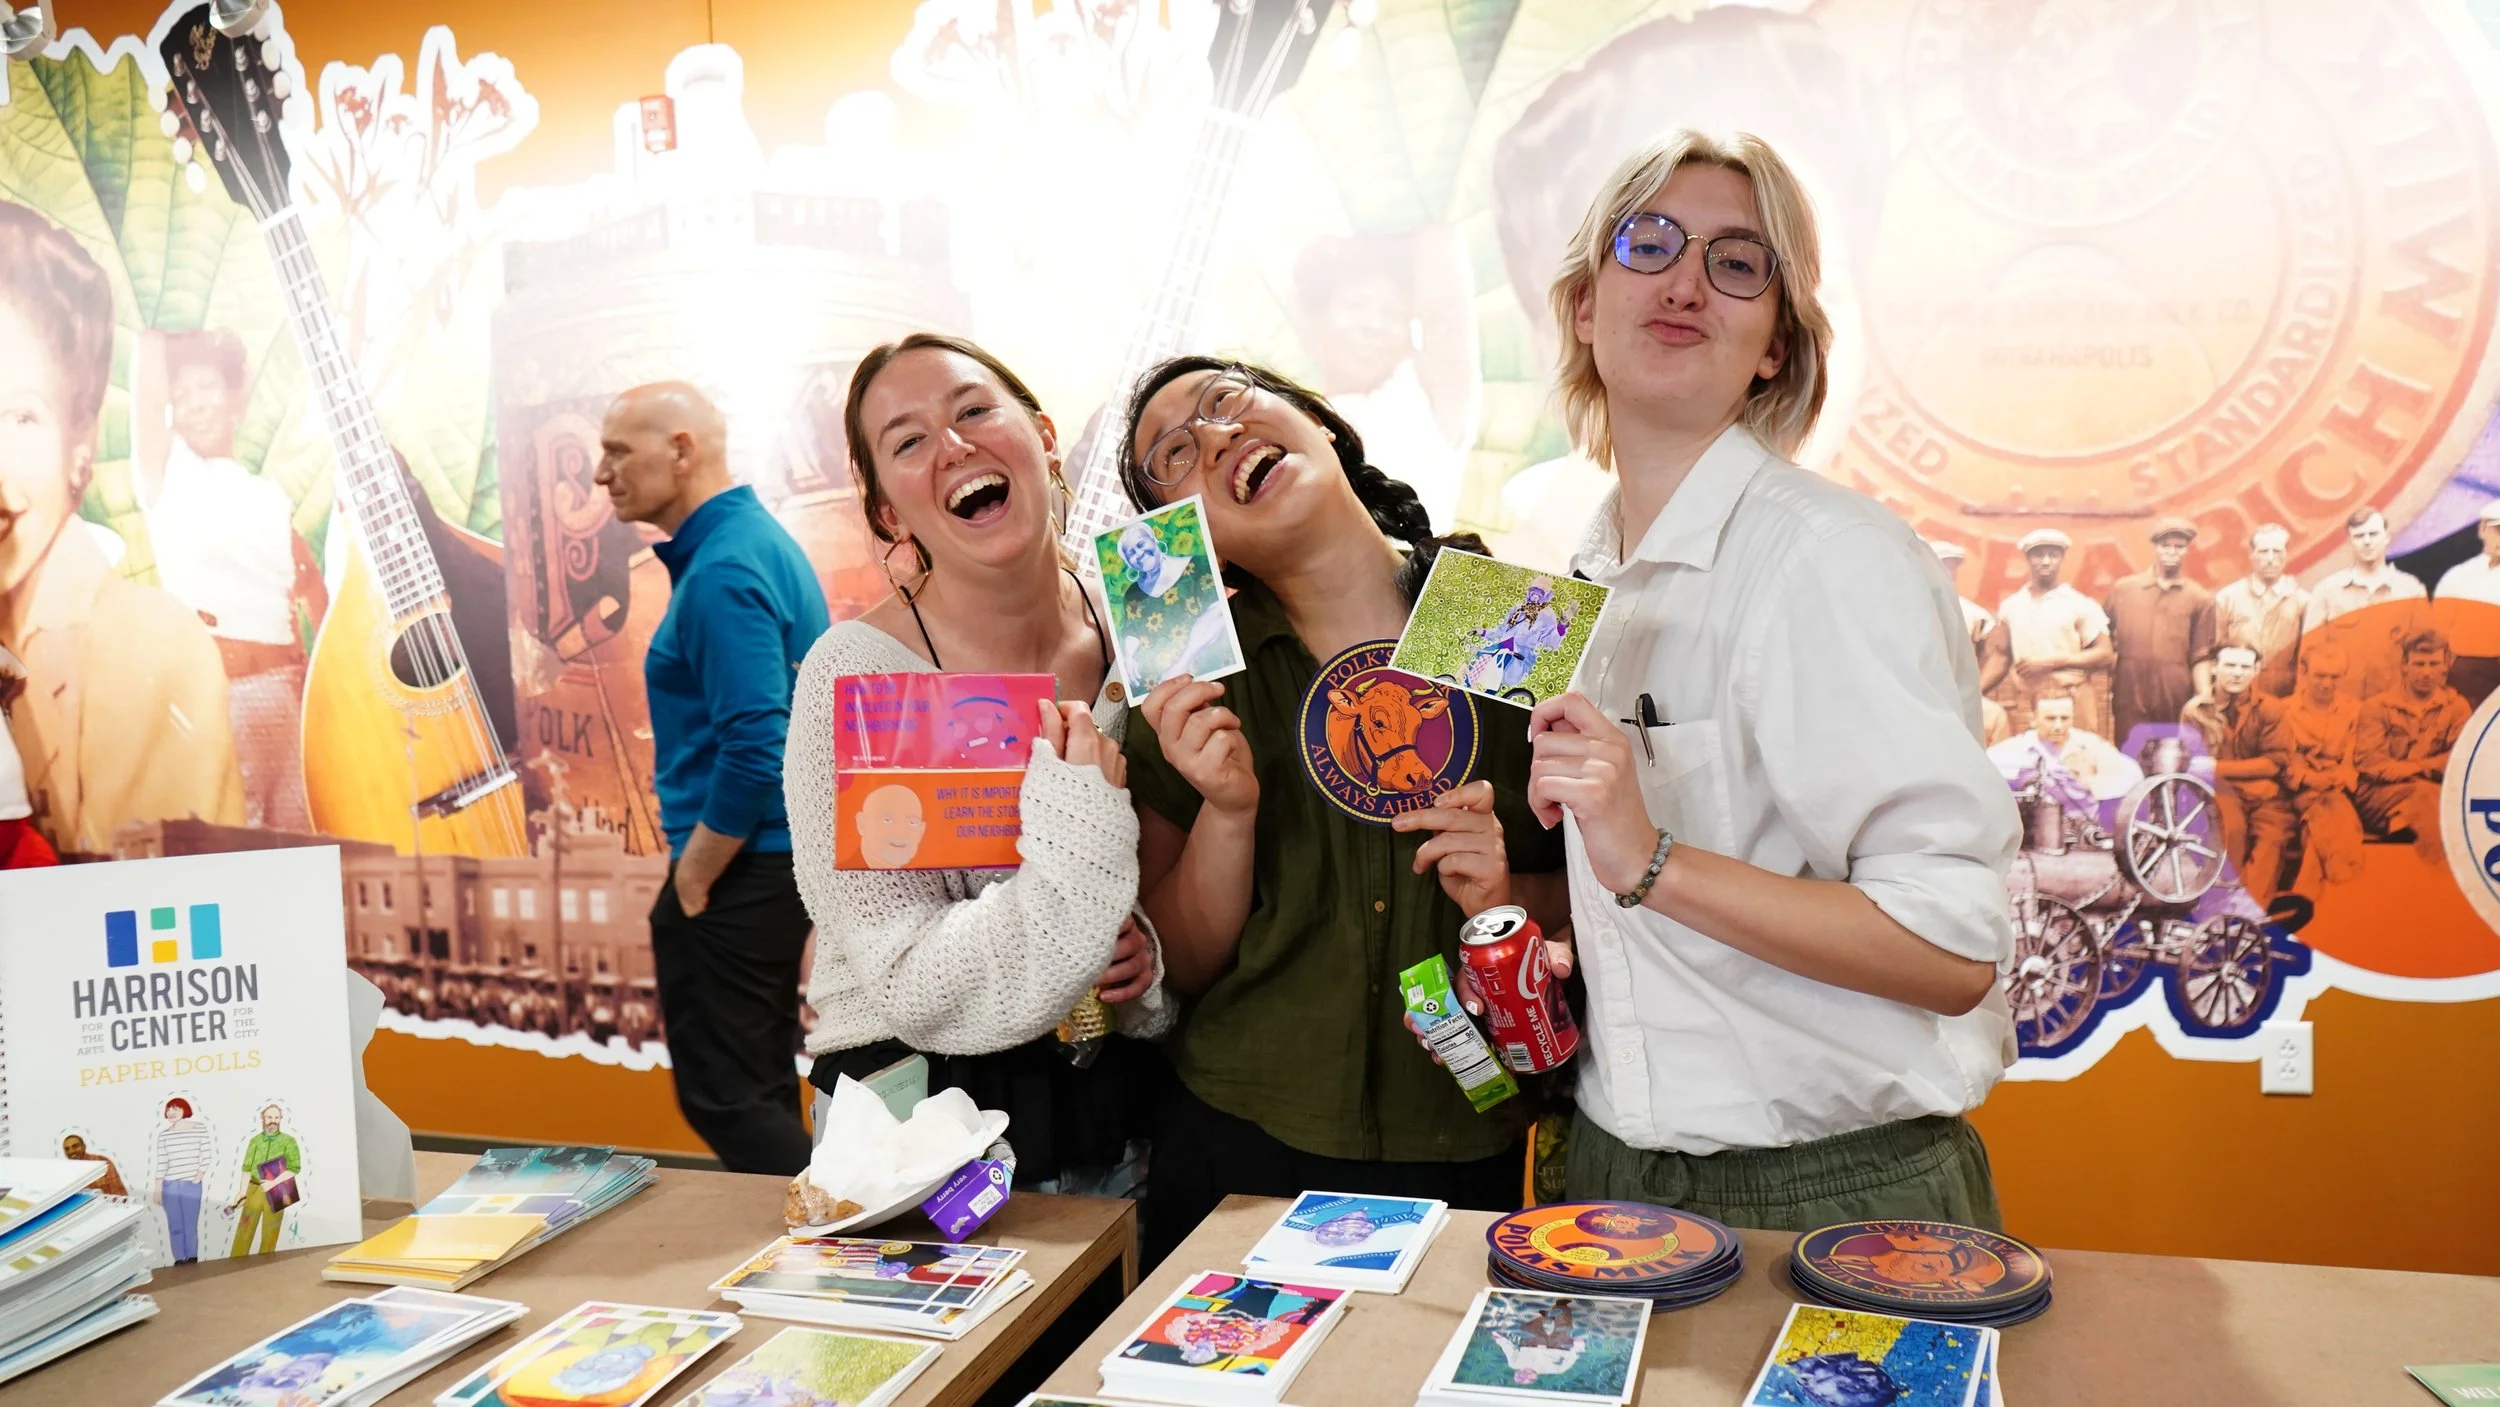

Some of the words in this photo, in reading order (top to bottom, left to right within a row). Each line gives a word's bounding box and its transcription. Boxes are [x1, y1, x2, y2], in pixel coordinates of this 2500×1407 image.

[2127, 150, 2341, 498] STANDARDIZED
[1311, 743, 1376, 811] ALWAYS
[1382, 776, 1453, 814] AHEAD
[936, 788, 957, 800] WHY
[960, 787, 969, 799] IT
[971, 787, 980, 799] IS
[944, 806, 974, 819] LEARN
[977, 805, 994, 818] THE
[957, 825, 976, 837] OUR
[73, 963, 259, 1019] HARRISON
[233, 1007, 255, 1017] FOR
[1525, 1005, 1538, 1023] ME
[81, 1022, 103, 1032] FOR
[233, 1018, 255, 1027] THE
[1425, 1022, 1449, 1035] Nutrition
[1448, 1014, 1463, 1025] Facts
[81, 1032, 104, 1044] THE
[110, 1010, 228, 1051] CENTER
[233, 1028, 260, 1039] CITY
[1437, 1042, 1457, 1053] Calories
[1465, 1029, 1475, 1039] 90
[1532, 1021, 1555, 1067] RECYCLE
[77, 1045, 105, 1056] ARTS
[79, 1060, 167, 1088] PAPER
[173, 1049, 262, 1076] DOLLS
[953, 1174, 968, 1188] very
[936, 1186, 955, 1203] berry
[1865, 1223, 1966, 1237] AHEAD
[1593, 1248, 1710, 1279] MILK
